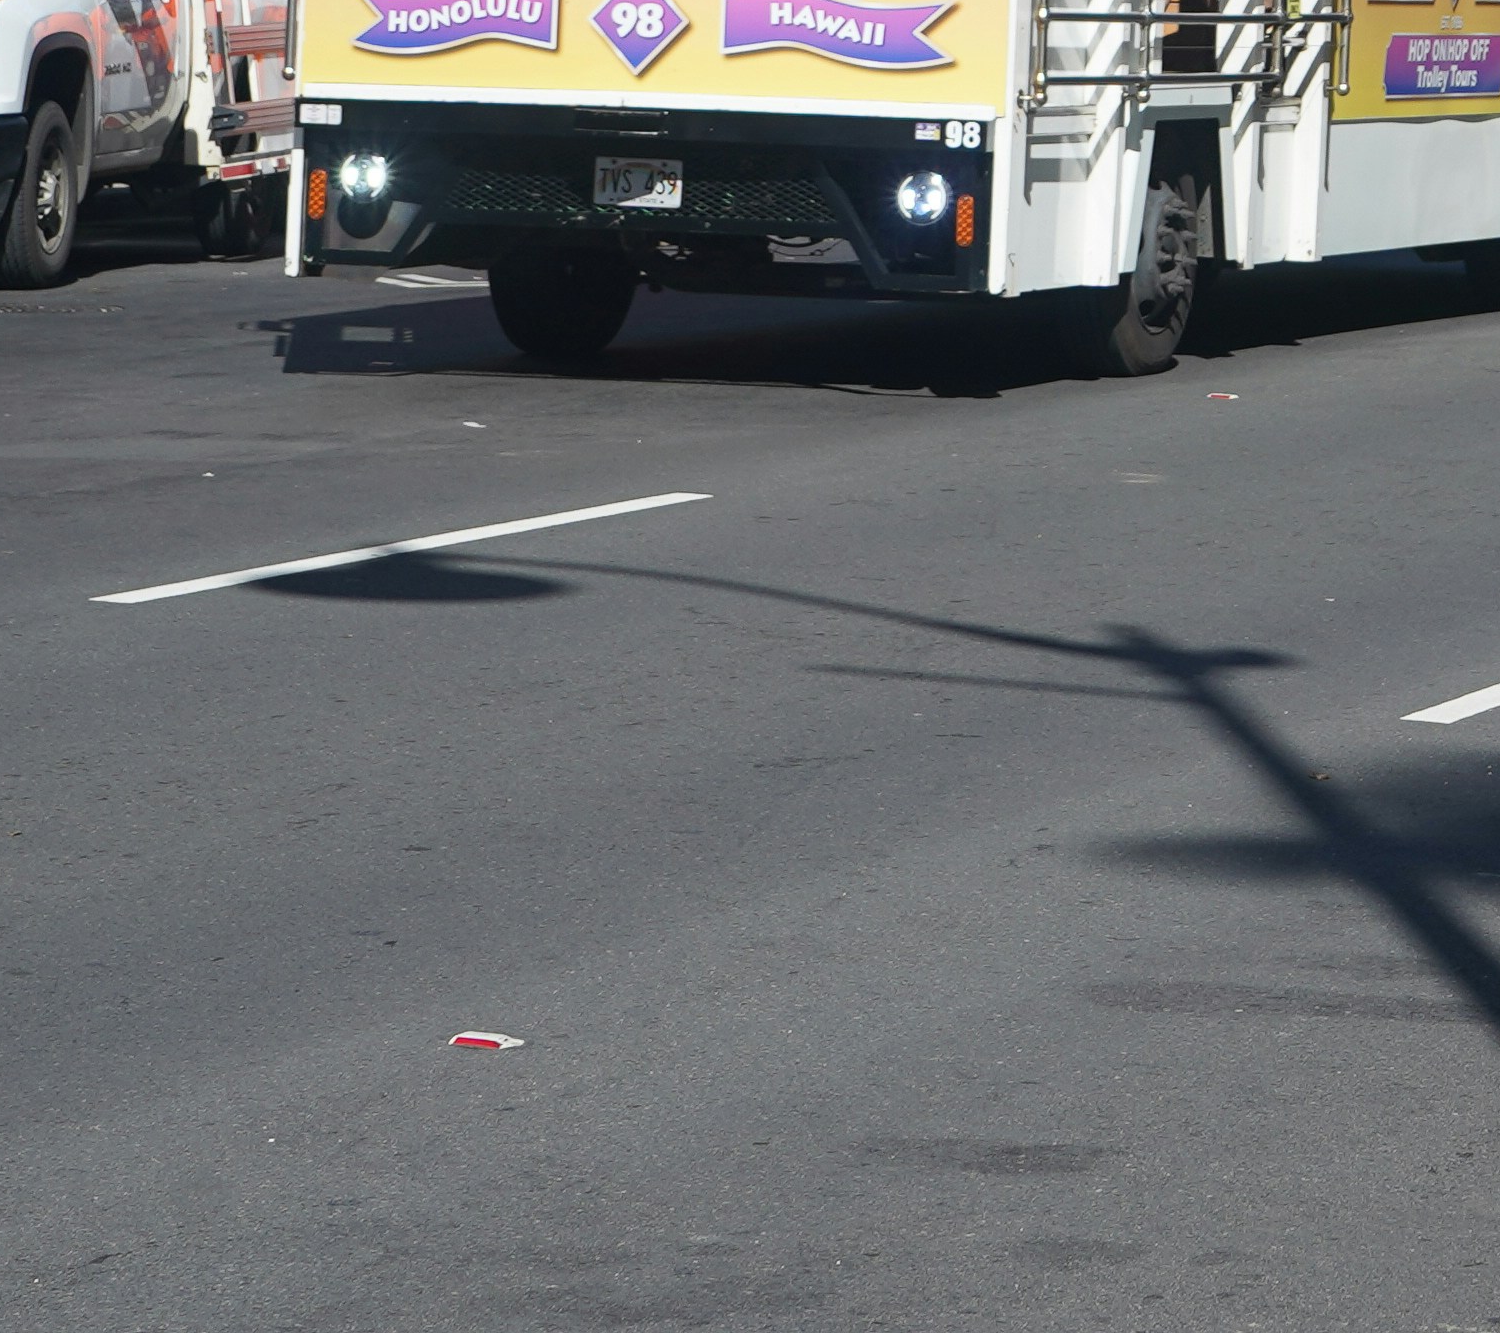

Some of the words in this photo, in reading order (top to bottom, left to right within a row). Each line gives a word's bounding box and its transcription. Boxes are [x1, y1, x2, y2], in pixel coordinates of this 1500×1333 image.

[611, 2, 665, 38] 98
[770, 2, 886, 46] HAWAII
[1408, 39, 1430, 62] HOP
[1470, 38, 1490, 61] OFF
[1417, 65, 1449, 92] Trolley
[1450, 64, 1477, 87] Tours
[945, 120, 981, 148] 98
[600, 168, 632, 193] TVS
[645, 171, 677, 195] 439
